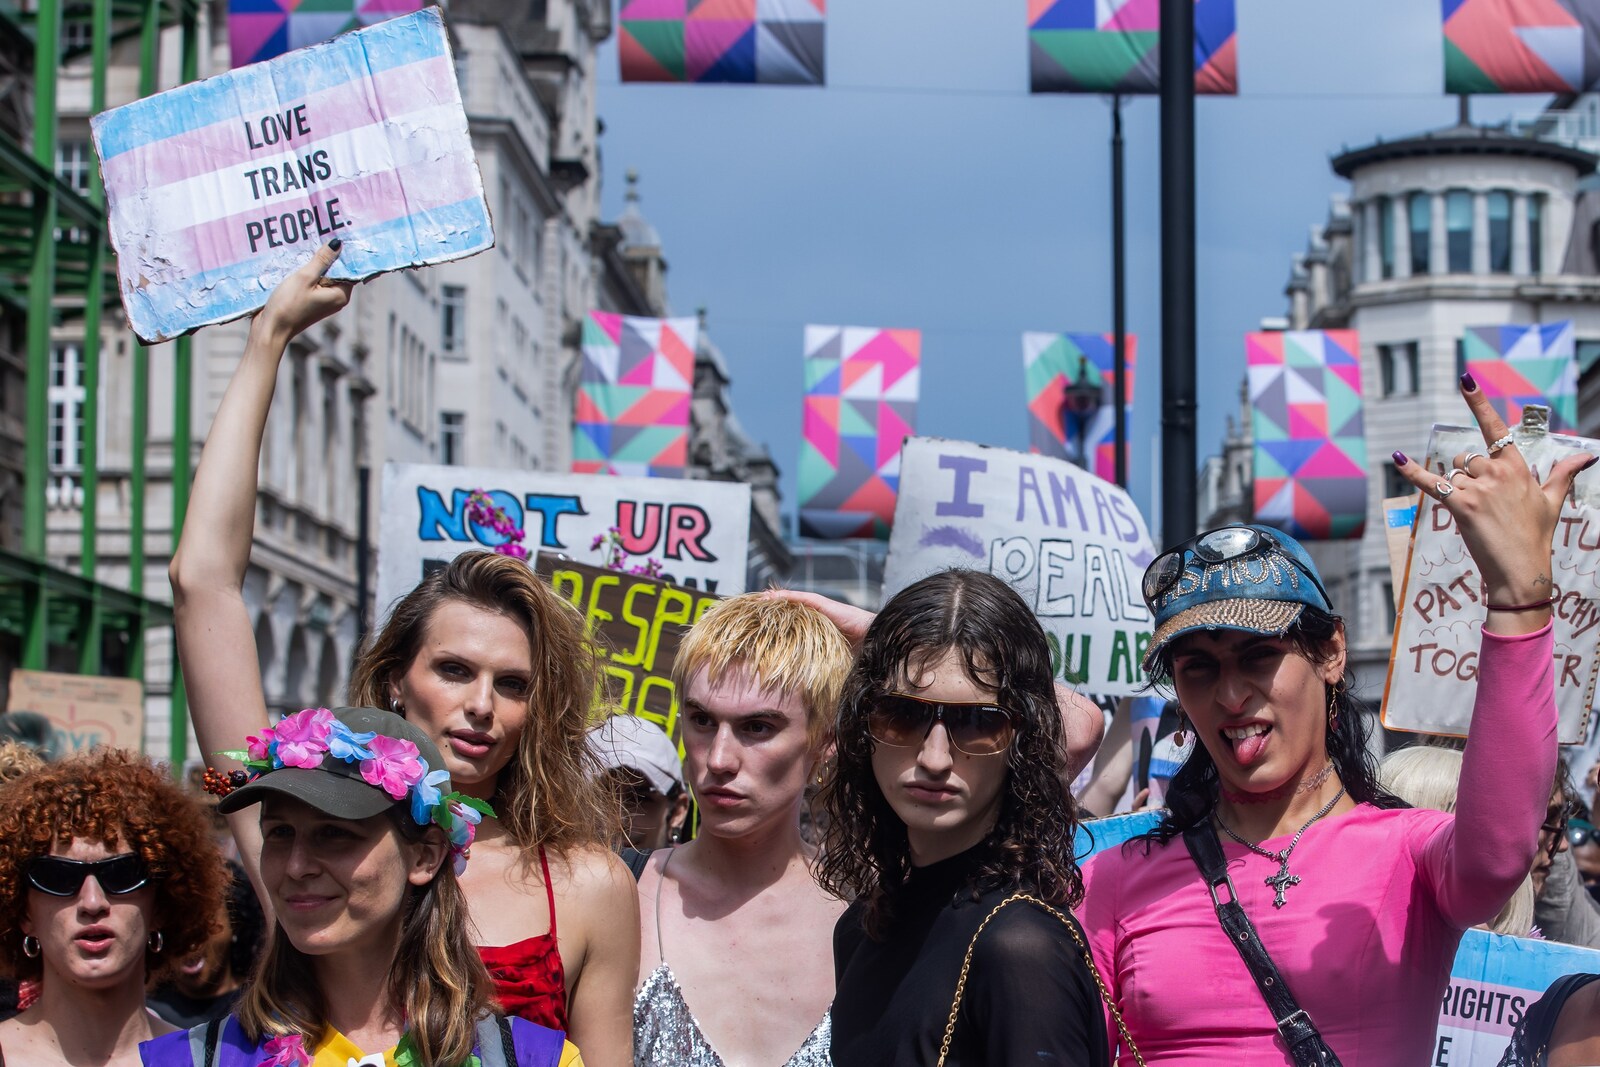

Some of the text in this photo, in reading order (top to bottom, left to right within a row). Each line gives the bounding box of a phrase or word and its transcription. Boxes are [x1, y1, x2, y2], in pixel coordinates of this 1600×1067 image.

[244, 104, 311, 150] LOVE
[244, 150, 332, 200] TRANS
[246, 198, 352, 253] PEOPLE.
[417, 485, 718, 562] NOT UR
[935, 454, 1140, 543] I AM AS
[1441, 984, 1526, 1028] RIGHTS
